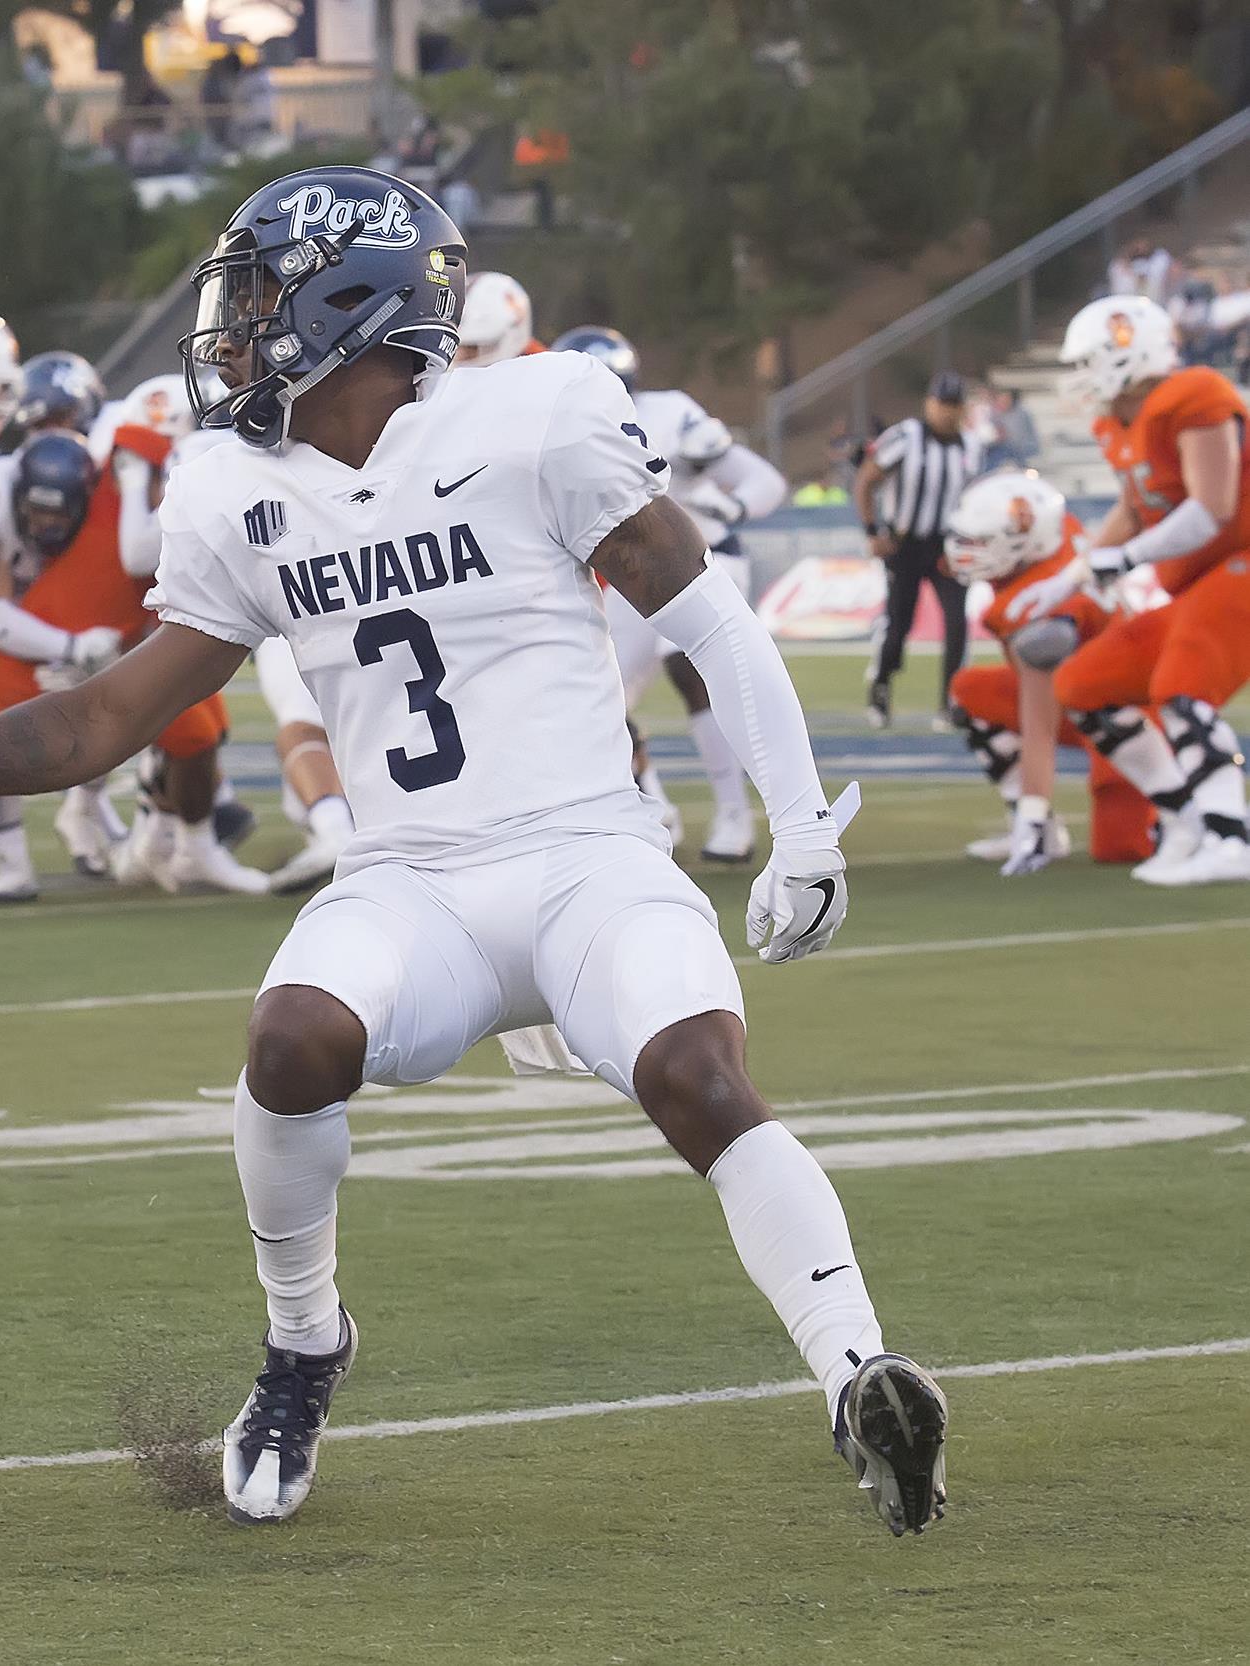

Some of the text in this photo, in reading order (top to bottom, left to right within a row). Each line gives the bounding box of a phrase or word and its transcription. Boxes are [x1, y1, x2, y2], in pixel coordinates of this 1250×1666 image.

[277, 185, 420, 250] Pack
[277, 523, 494, 620] NEVADA
[352, 607, 467, 793] 3
